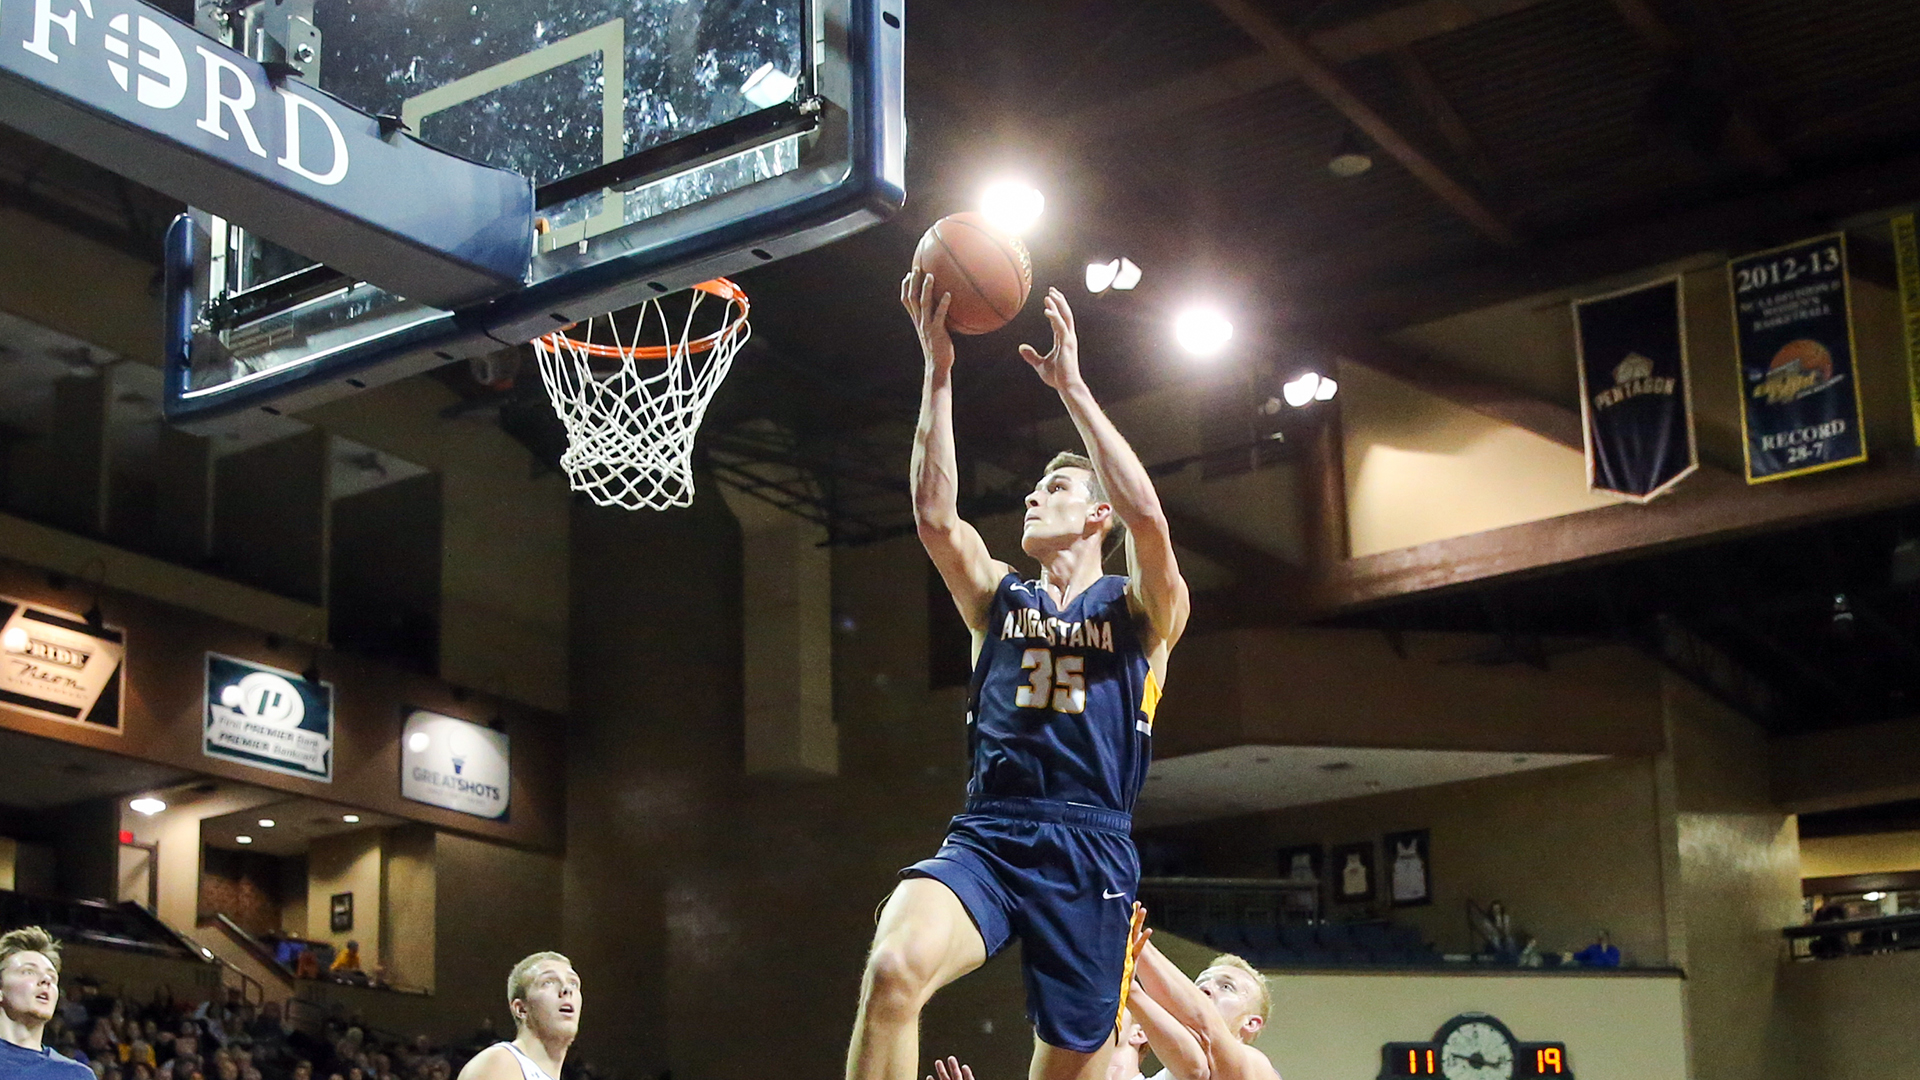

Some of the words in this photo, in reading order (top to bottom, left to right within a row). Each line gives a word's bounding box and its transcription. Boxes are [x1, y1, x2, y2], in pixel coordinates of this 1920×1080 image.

[1738, 246, 1840, 293] 2012-13
[1594, 376, 1676, 411] PENTAGON
[1761, 419, 1846, 452] RECORD
[1001, 607, 1115, 653] AUGUSTANA
[1015, 647, 1087, 714] 35
[219, 730, 270, 752] PREMIER
[244, 721, 295, 742] PREMIER
[1408, 1049, 1435, 1075] 11
[1536, 1047, 1562, 1075] 19
